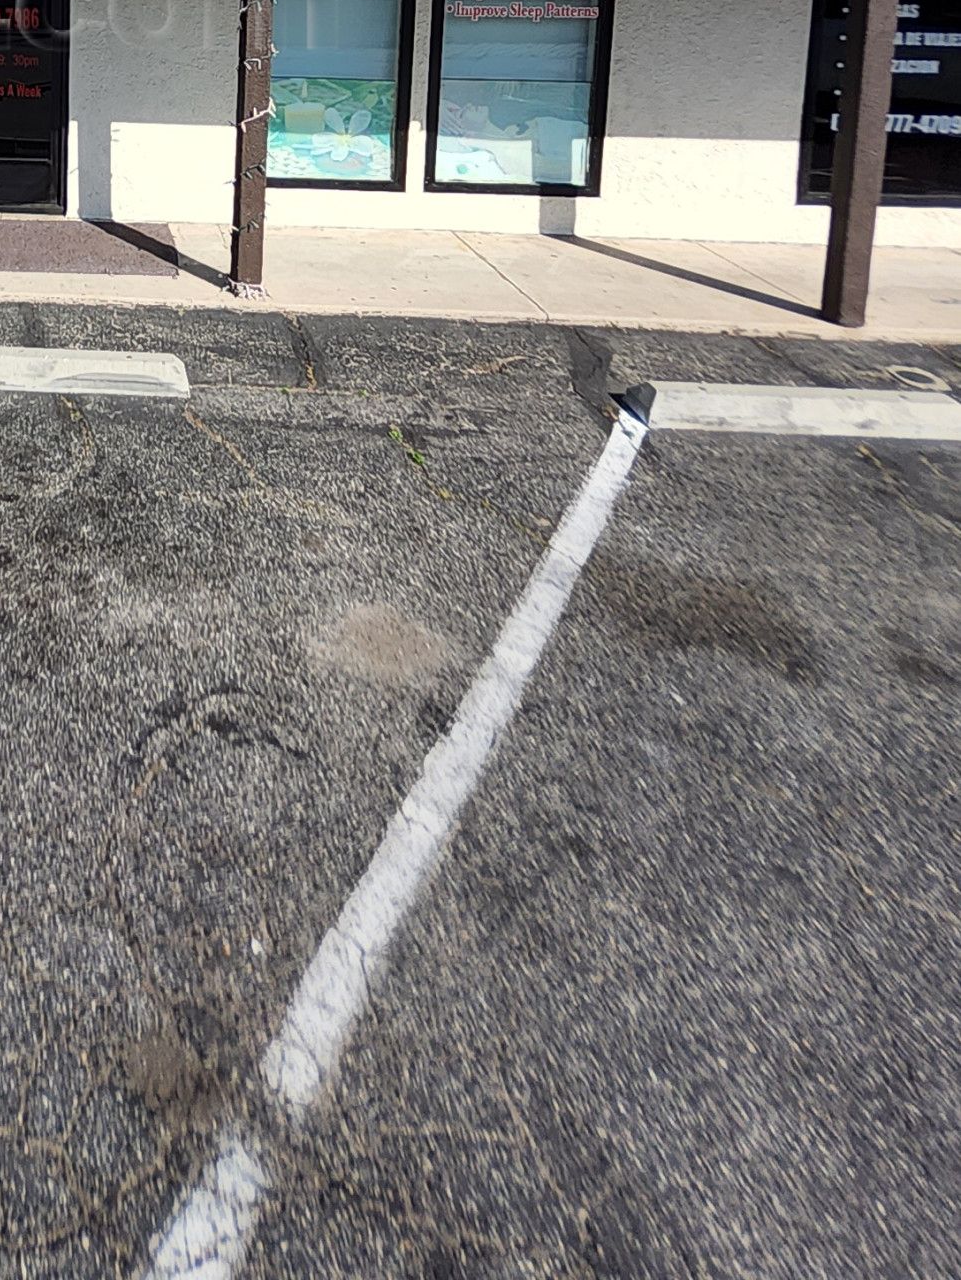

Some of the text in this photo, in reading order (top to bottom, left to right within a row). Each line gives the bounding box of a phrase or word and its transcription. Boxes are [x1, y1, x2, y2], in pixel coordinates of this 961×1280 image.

[454, 1, 599, 22] Improve Sleep Patterns
[7, 84, 15, 97] A
[17, 84, 41, 98] Week
